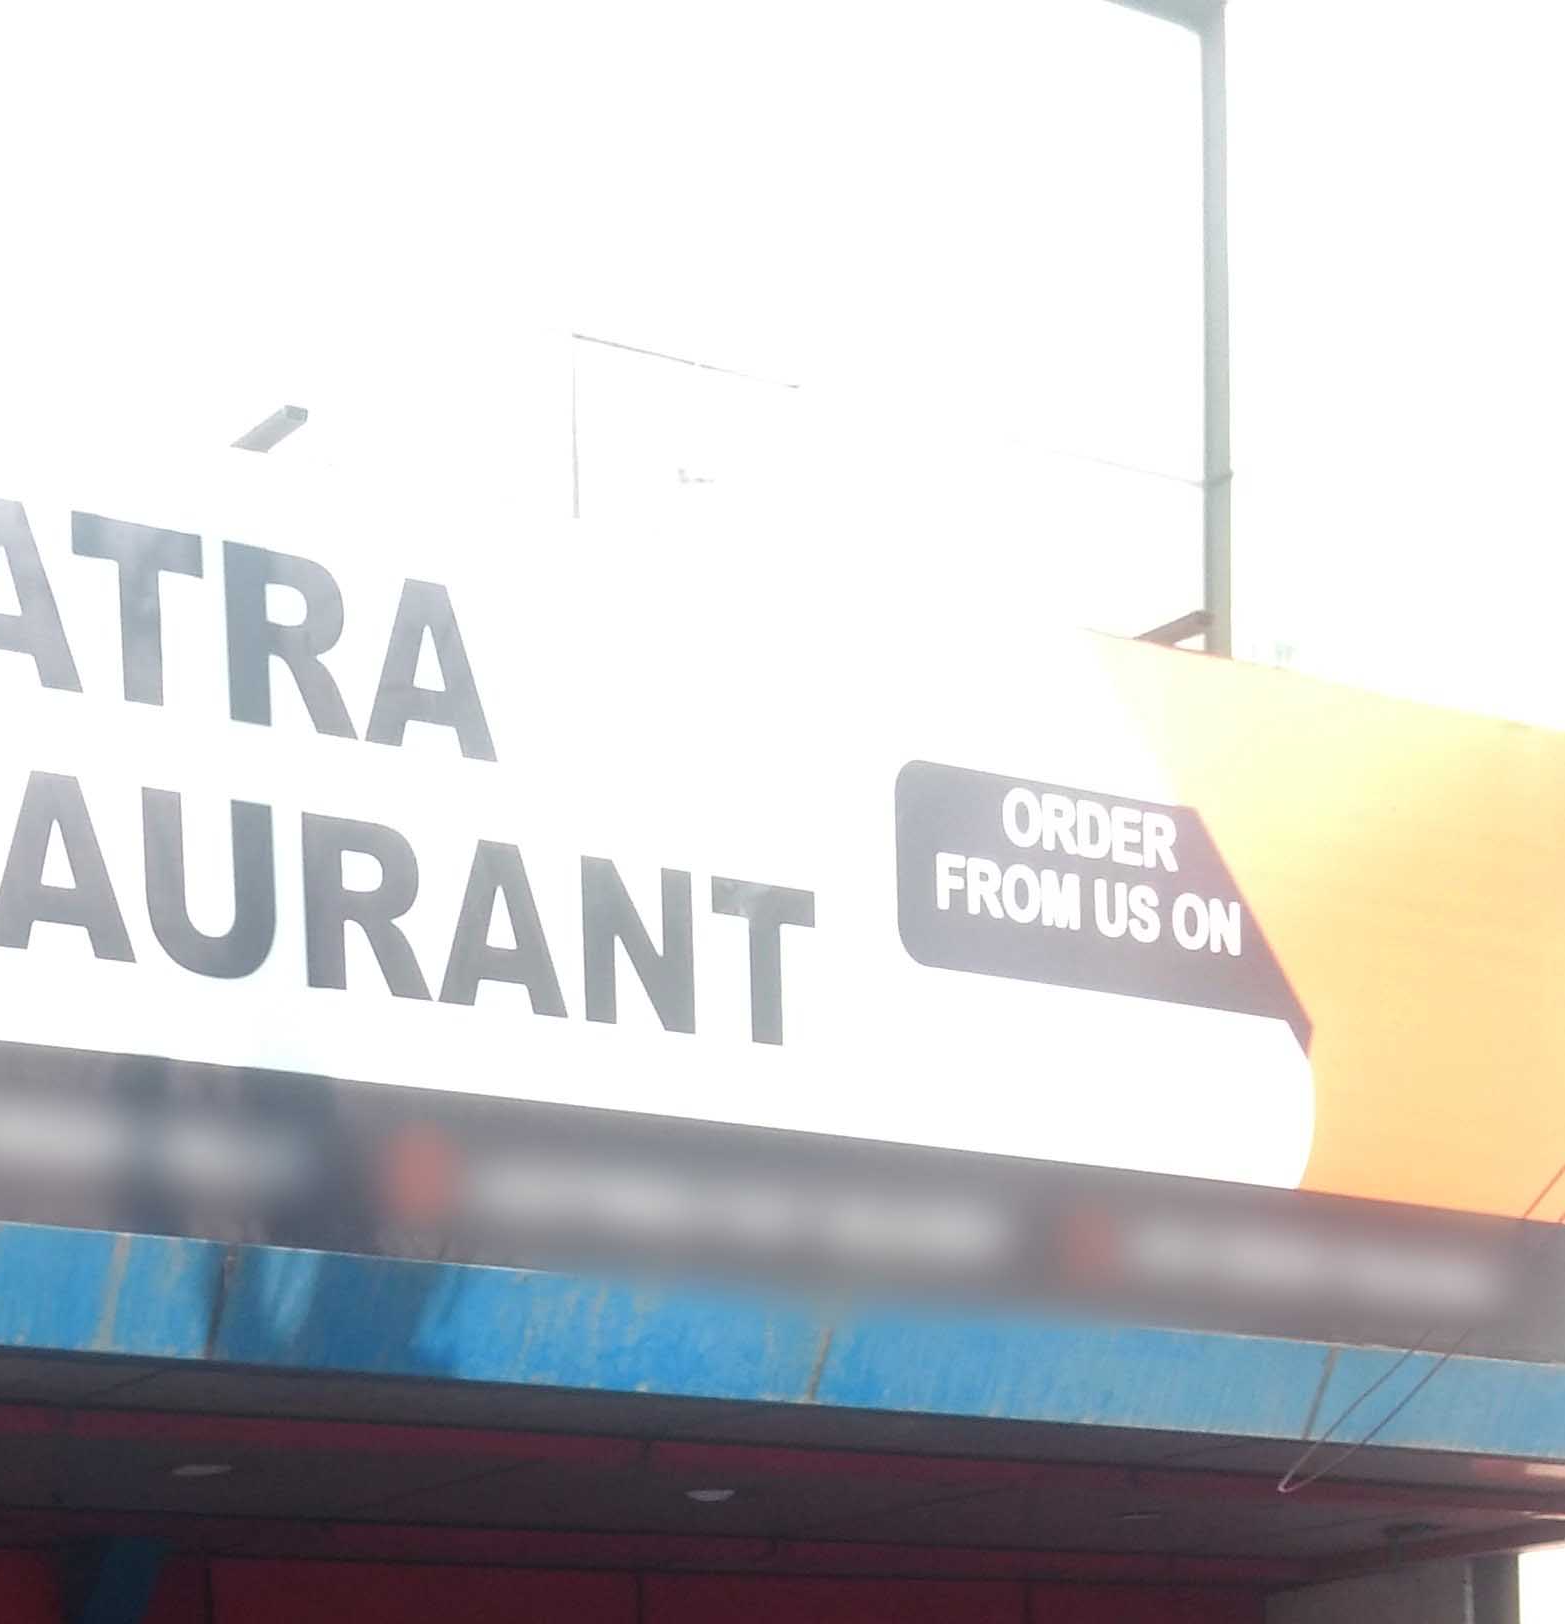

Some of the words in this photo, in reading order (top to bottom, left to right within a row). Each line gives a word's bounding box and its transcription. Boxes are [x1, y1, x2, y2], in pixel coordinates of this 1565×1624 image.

[1002, 787, 1179, 872] ORDER
[936, 851, 1081, 930] FROM
[1094, 878, 1161, 943] US
[1172, 892, 1243, 957] ON
